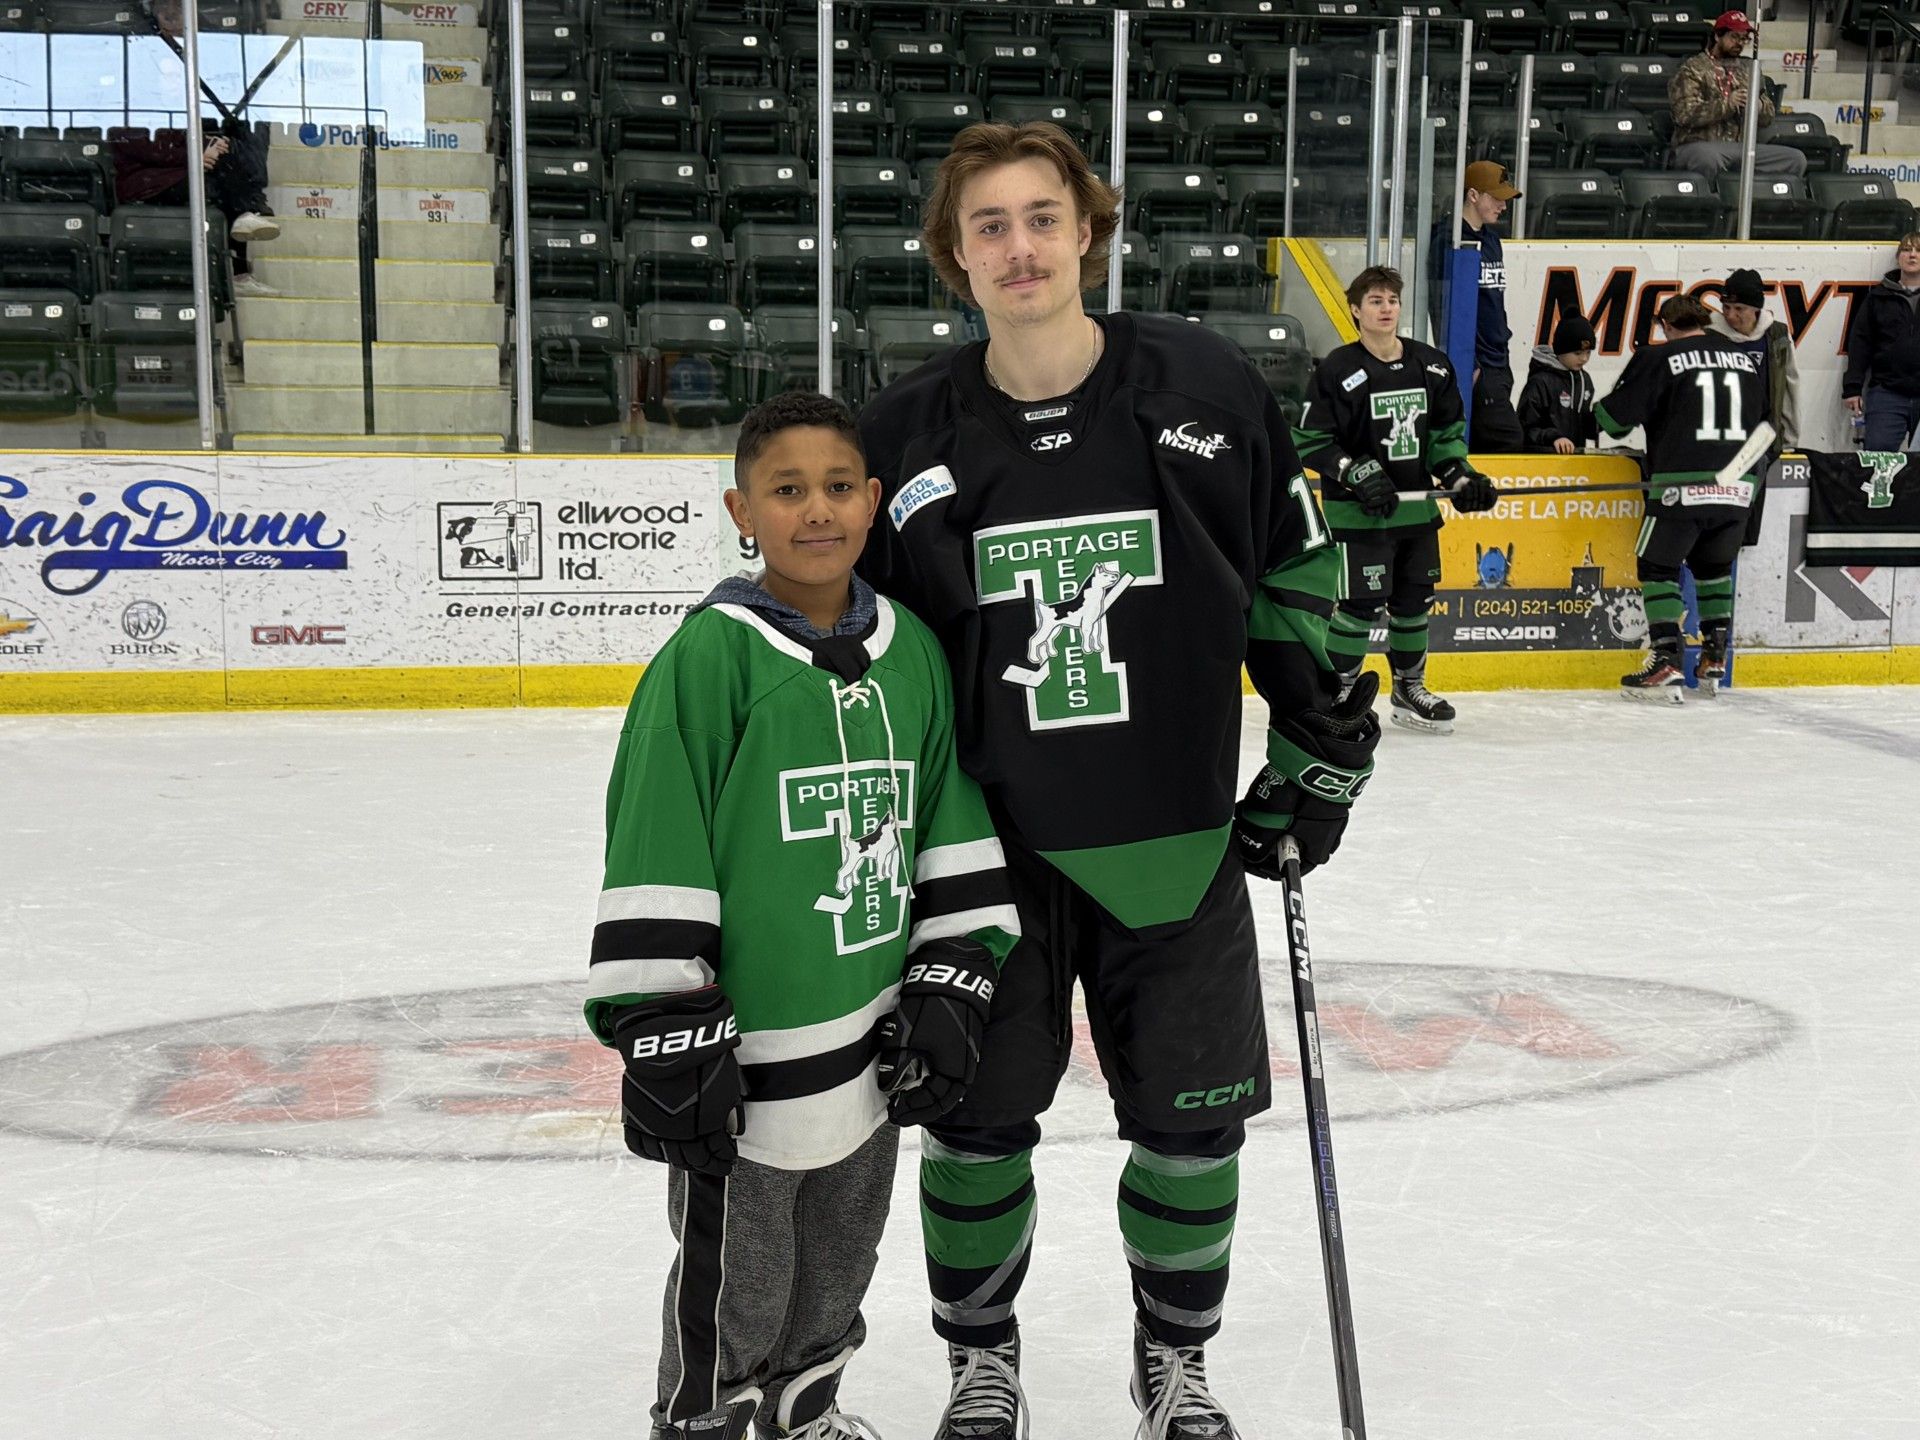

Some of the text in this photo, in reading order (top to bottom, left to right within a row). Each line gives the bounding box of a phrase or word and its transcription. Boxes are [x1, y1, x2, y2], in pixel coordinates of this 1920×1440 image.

[303, 2, 348, 16] CFRY
[413, 5, 458, 19] CFRY
[329, 125, 459, 150] Portgeline
[296, 196, 333, 209] COUNTRY
[419, 199, 455, 211] COUNTRY
[1668, 350, 1757, 376] BULLINGE
[1028, 407, 1065, 419] BAUER
[1695, 370, 1747, 441] 11
[1038, 432, 1073, 452] SP
[900, 479, 935, 506] BLUE
[905, 483, 950, 513] CROSS
[121, 479, 347, 550] Dunn
[557, 501, 703, 524] ellwood-
[1289, 474, 1327, 551] 1
[1530, 500, 1559, 519] LA
[558, 527, 677, 551] mcrorie
[988, 529, 1140, 566] PORTAGE
[161, 551, 284, 569] Motor City
[559, 557, 604, 581] ltd.
[445, 601, 700, 618] General Contractors
[1474, 599, 1594, 617] (204) 521-1059
[251, 624, 347, 646] GMC
[110, 643, 179, 655] BUICK
[1289, 889, 1312, 982] CCM
[1173, 1076, 1255, 1110] CCM
